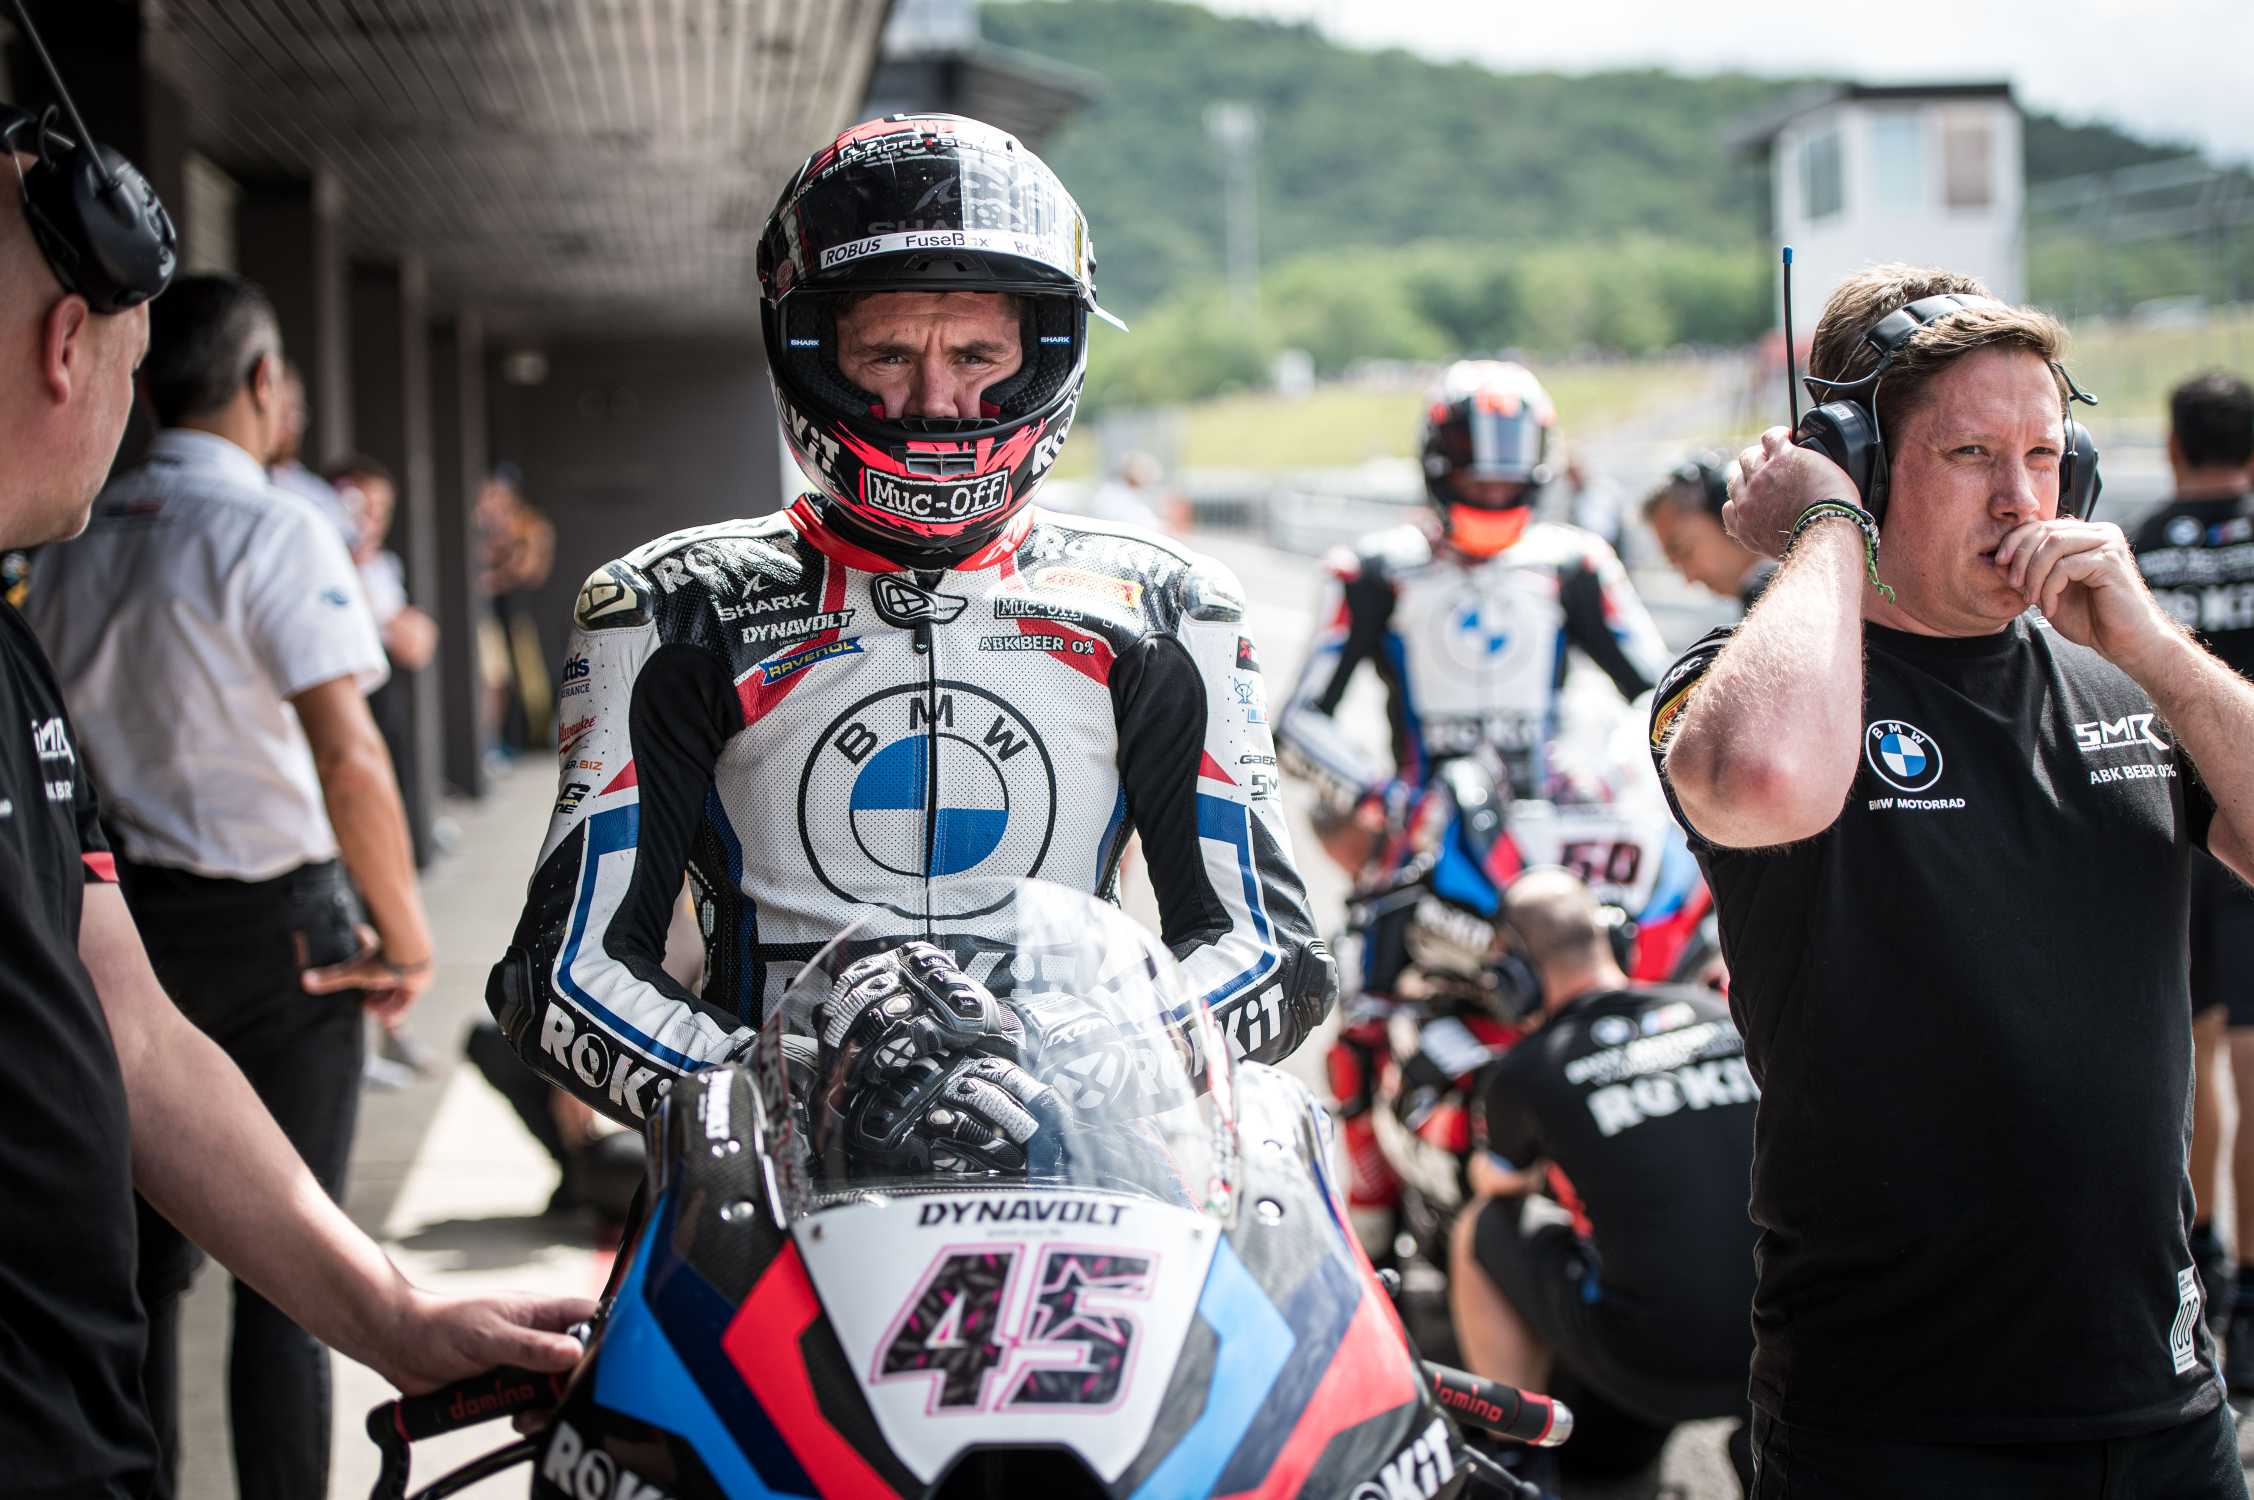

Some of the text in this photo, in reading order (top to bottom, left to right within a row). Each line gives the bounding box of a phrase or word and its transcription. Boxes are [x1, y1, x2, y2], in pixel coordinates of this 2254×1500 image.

[825, 238, 882, 266] ROBUS
[905, 232, 989, 248] FuseBx
[872, 476, 1004, 516] Muc-Off
[717, 591, 811, 622] SHARK
[741, 610, 854, 644] DYNAVOLT
[979, 636, 1020, 651] ABK
[1021, 637, 1064, 651] BEER
[834, 696, 1029, 764] BMW
[1872, 723, 1925, 745] BMW
[2089, 763, 2177, 785] ABK BEER 0%
[1868, 798, 1966, 811] BMW MOTORRAD
[917, 1199, 1131, 1228] DYNAVOLT
[868, 1243, 1161, 1416] 45
[449, 1382, 534, 1422] domino
